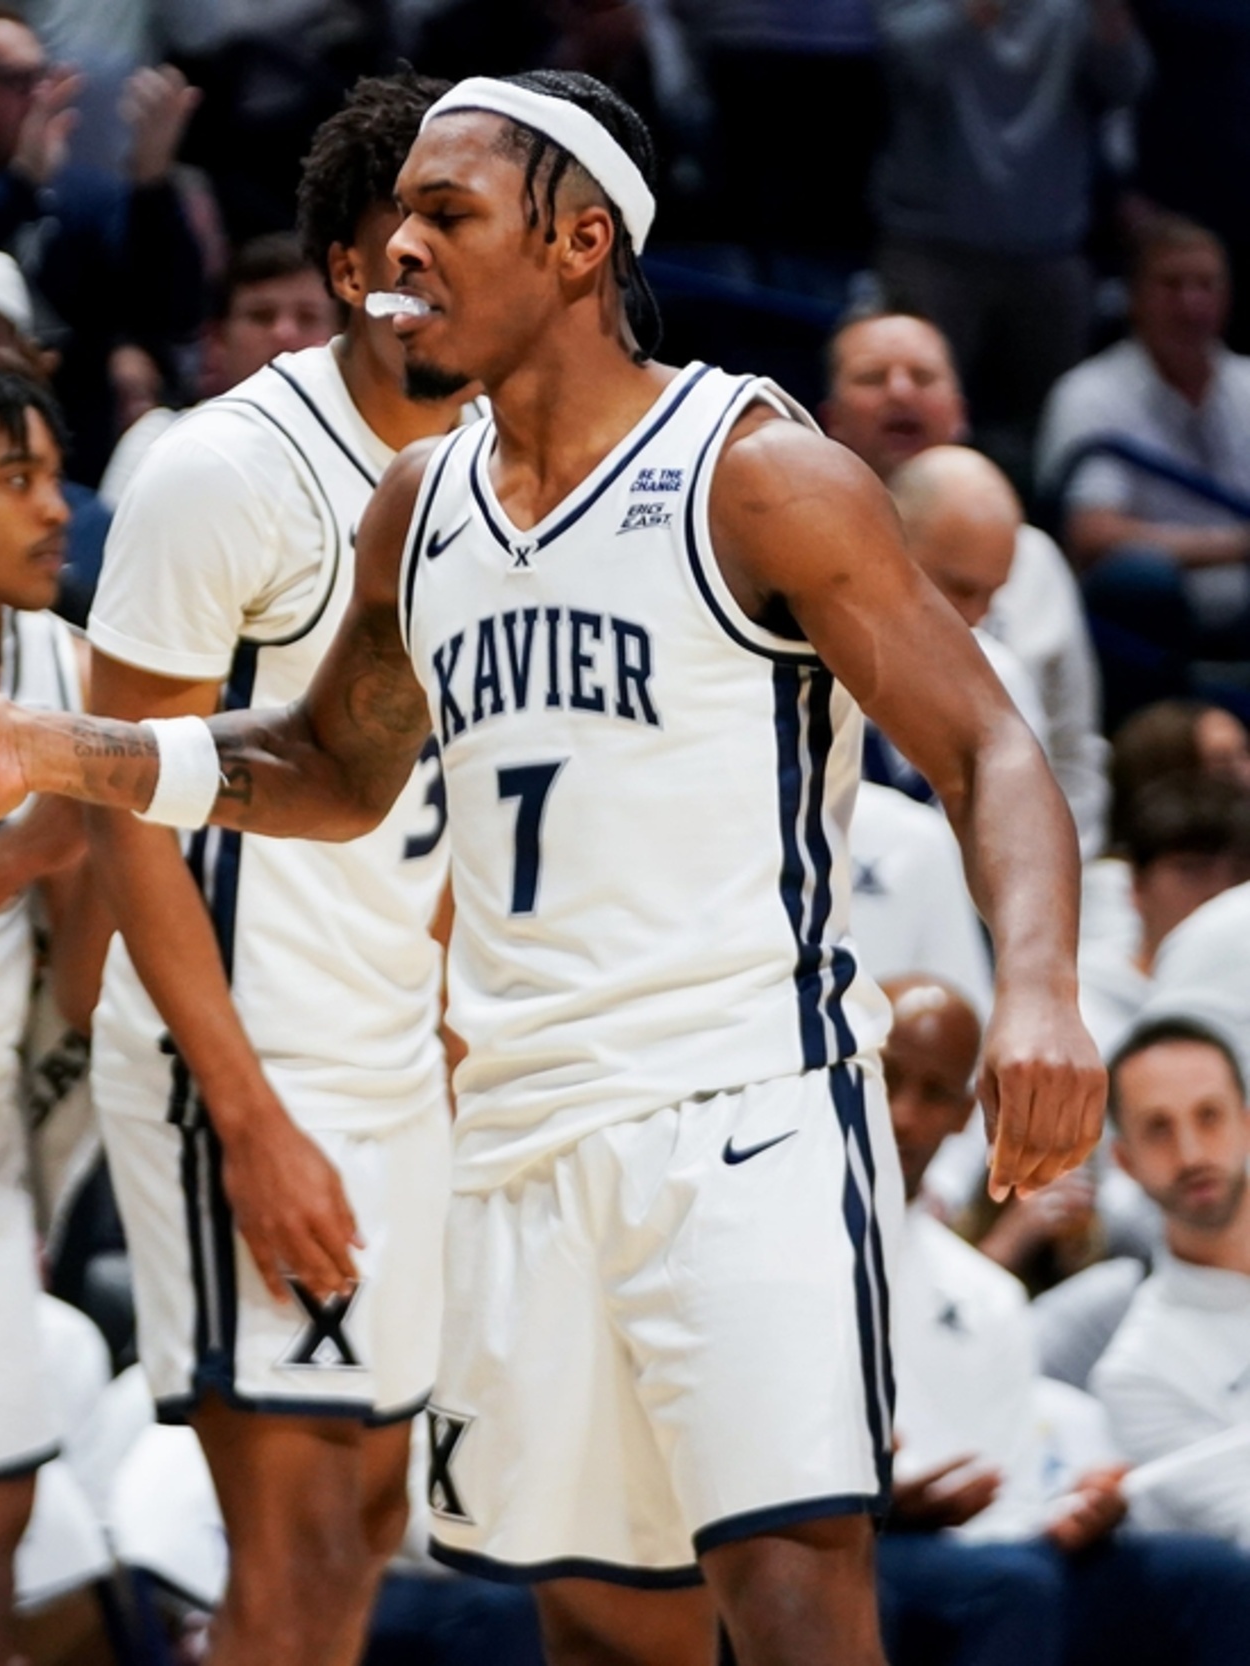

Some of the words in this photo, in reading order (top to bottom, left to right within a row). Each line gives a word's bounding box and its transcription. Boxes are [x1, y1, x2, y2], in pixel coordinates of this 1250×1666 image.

[630, 480, 682, 493] CHANGE
[432, 606, 662, 748] XAVIER
[496, 756, 570, 917] 7
